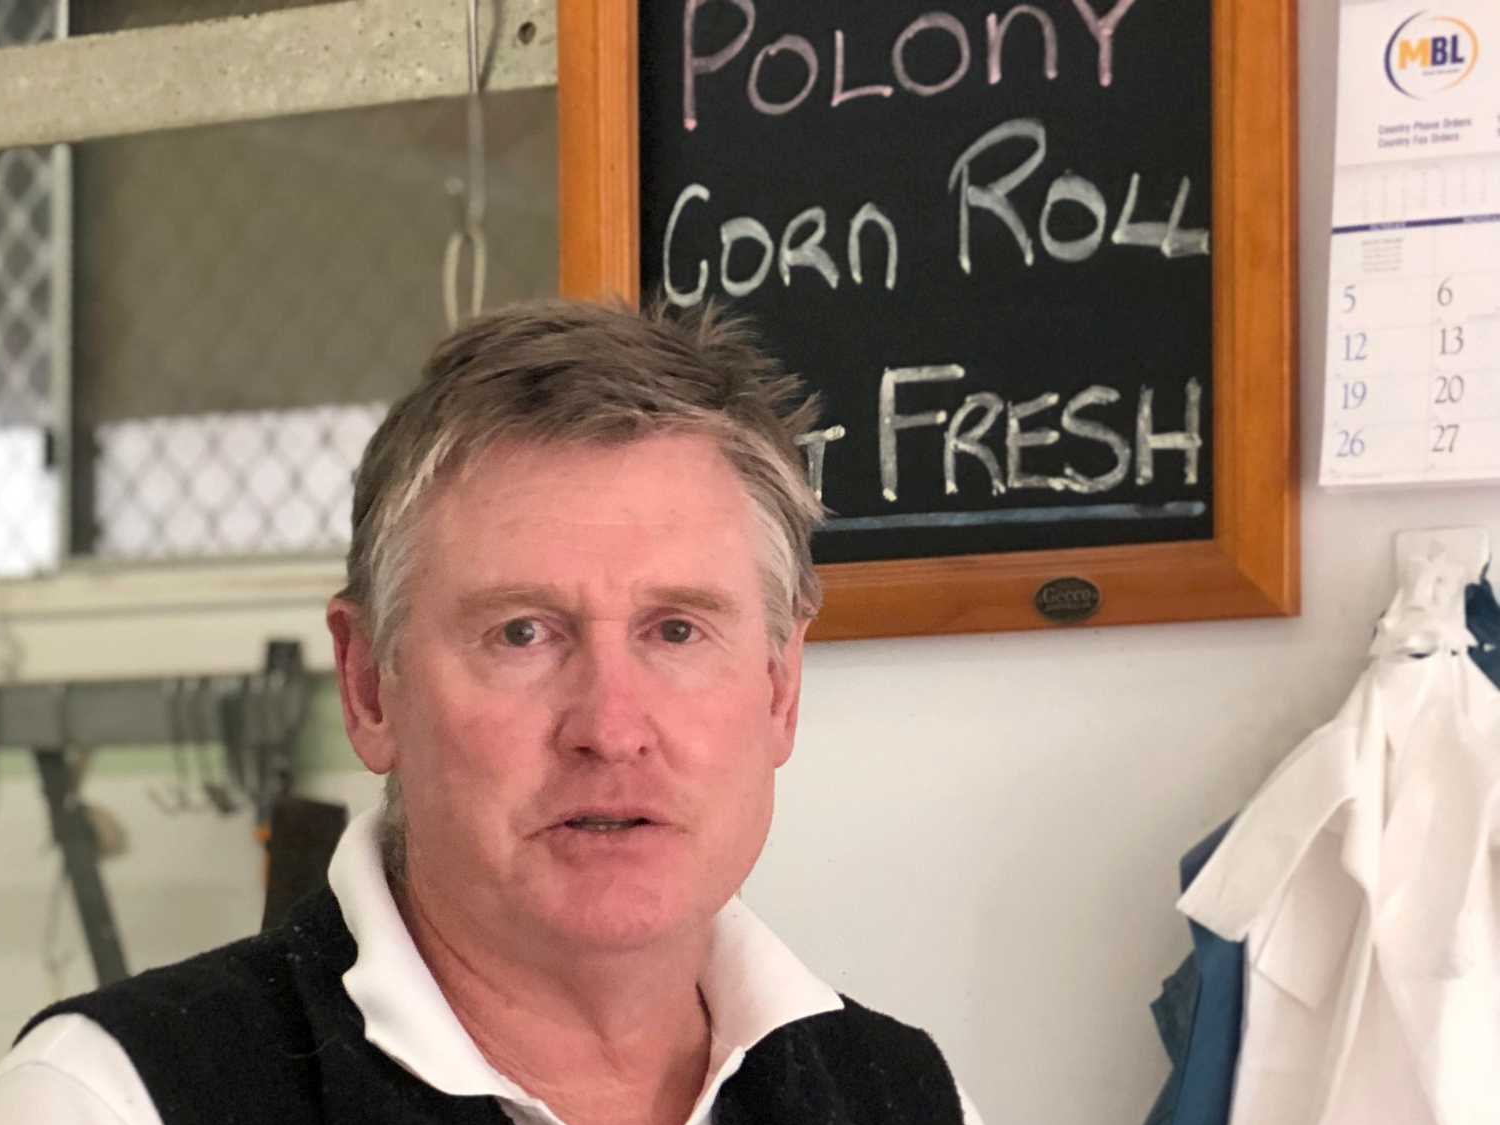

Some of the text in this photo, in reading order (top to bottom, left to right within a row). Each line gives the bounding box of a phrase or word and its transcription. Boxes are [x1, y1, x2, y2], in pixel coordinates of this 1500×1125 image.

[682, 0, 1137, 130] POLONY
[1397, 34, 1465, 70] MBL
[663, 118, 1210, 307] CORN ROLL
[1342, 284, 1357, 313] 5
[1436, 277, 1453, 306] 6
[1343, 331, 1368, 361] 12
[1439, 325, 1465, 355] 13
[1341, 380, 1367, 410] 19
[1434, 375, 1465, 404] 20
[878, 364, 1203, 501] FRESH
[1336, 429, 1366, 458] 26
[1431, 423, 1461, 453] 27
